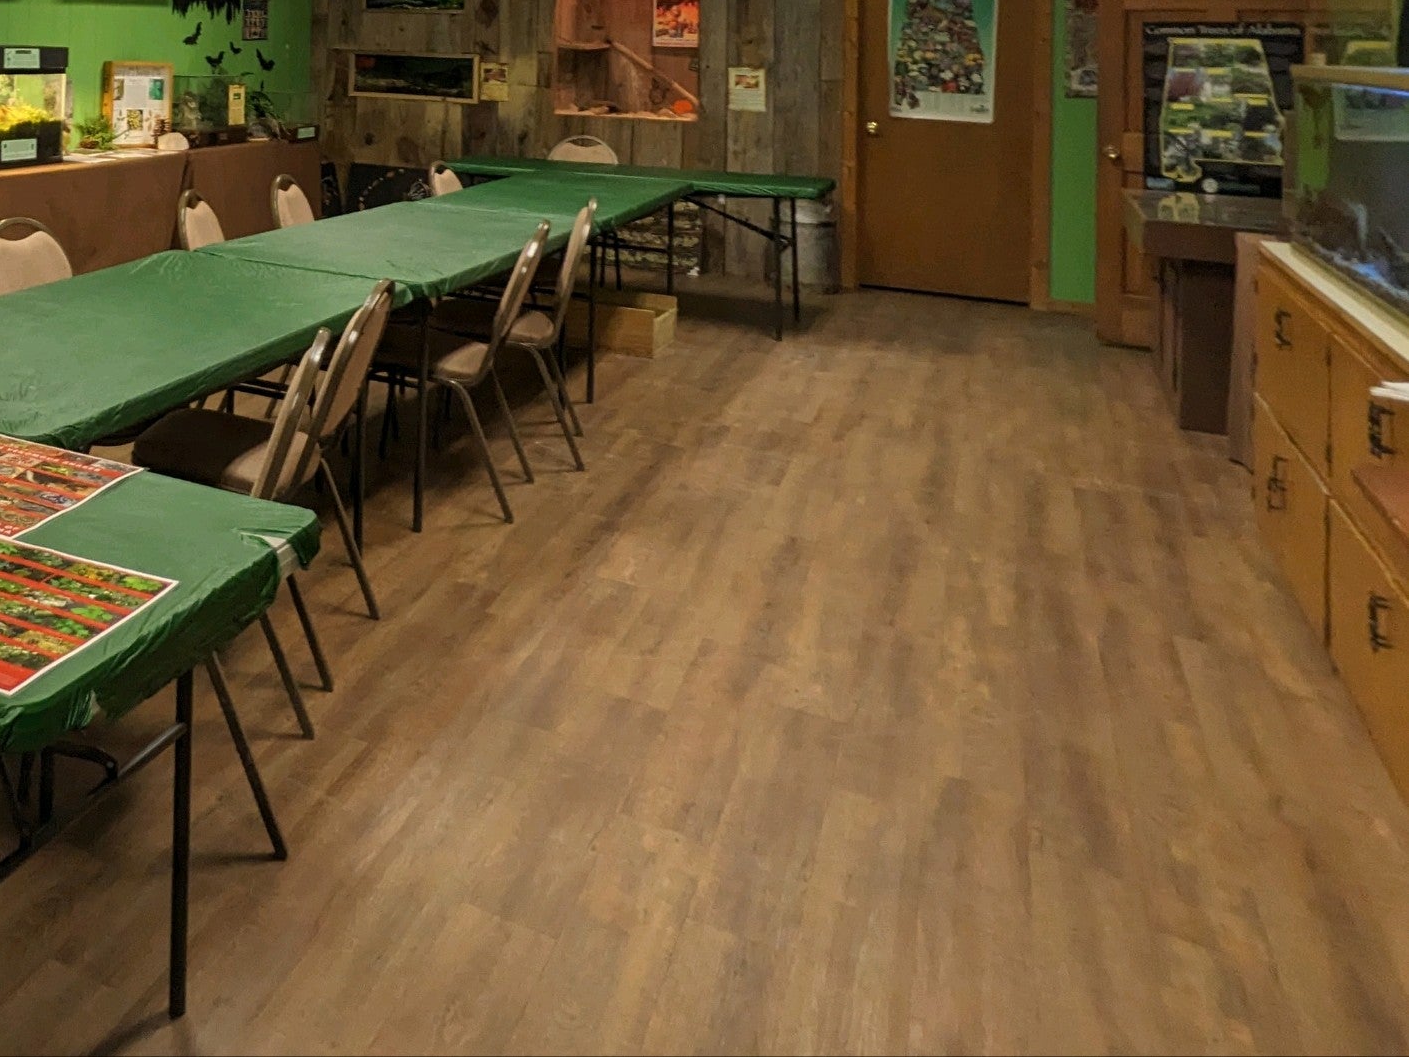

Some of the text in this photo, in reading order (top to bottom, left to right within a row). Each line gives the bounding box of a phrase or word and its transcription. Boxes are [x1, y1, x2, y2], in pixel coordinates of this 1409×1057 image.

[1144, 26, 1195, 35] Common
[1196, 25, 1230, 35] Trees
[1247, 23, 1302, 35] Alabama
